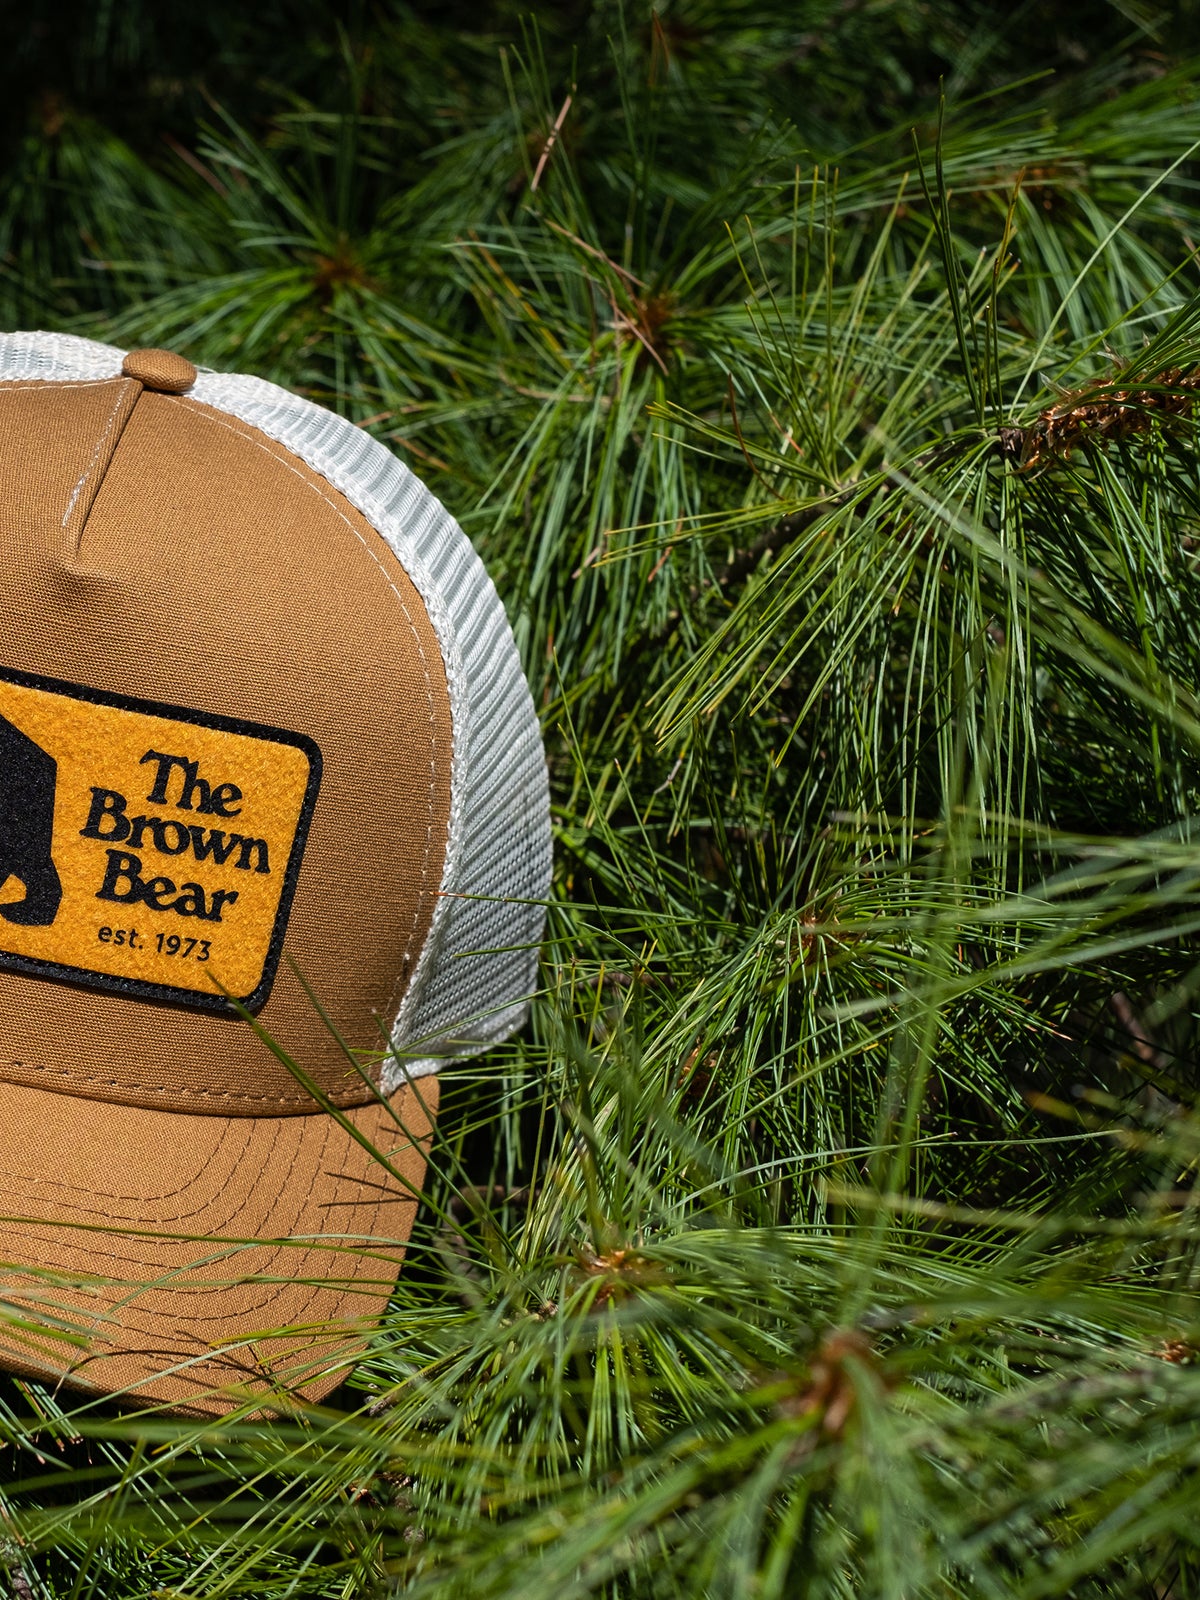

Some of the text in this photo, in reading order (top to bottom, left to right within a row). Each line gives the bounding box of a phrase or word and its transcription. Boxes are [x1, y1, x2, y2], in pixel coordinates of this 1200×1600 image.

[139, 749, 243, 817] The
[79, 786, 271, 874] Brown
[95, 849, 239, 922] Bear
[98, 926, 212, 962] est. 1973
